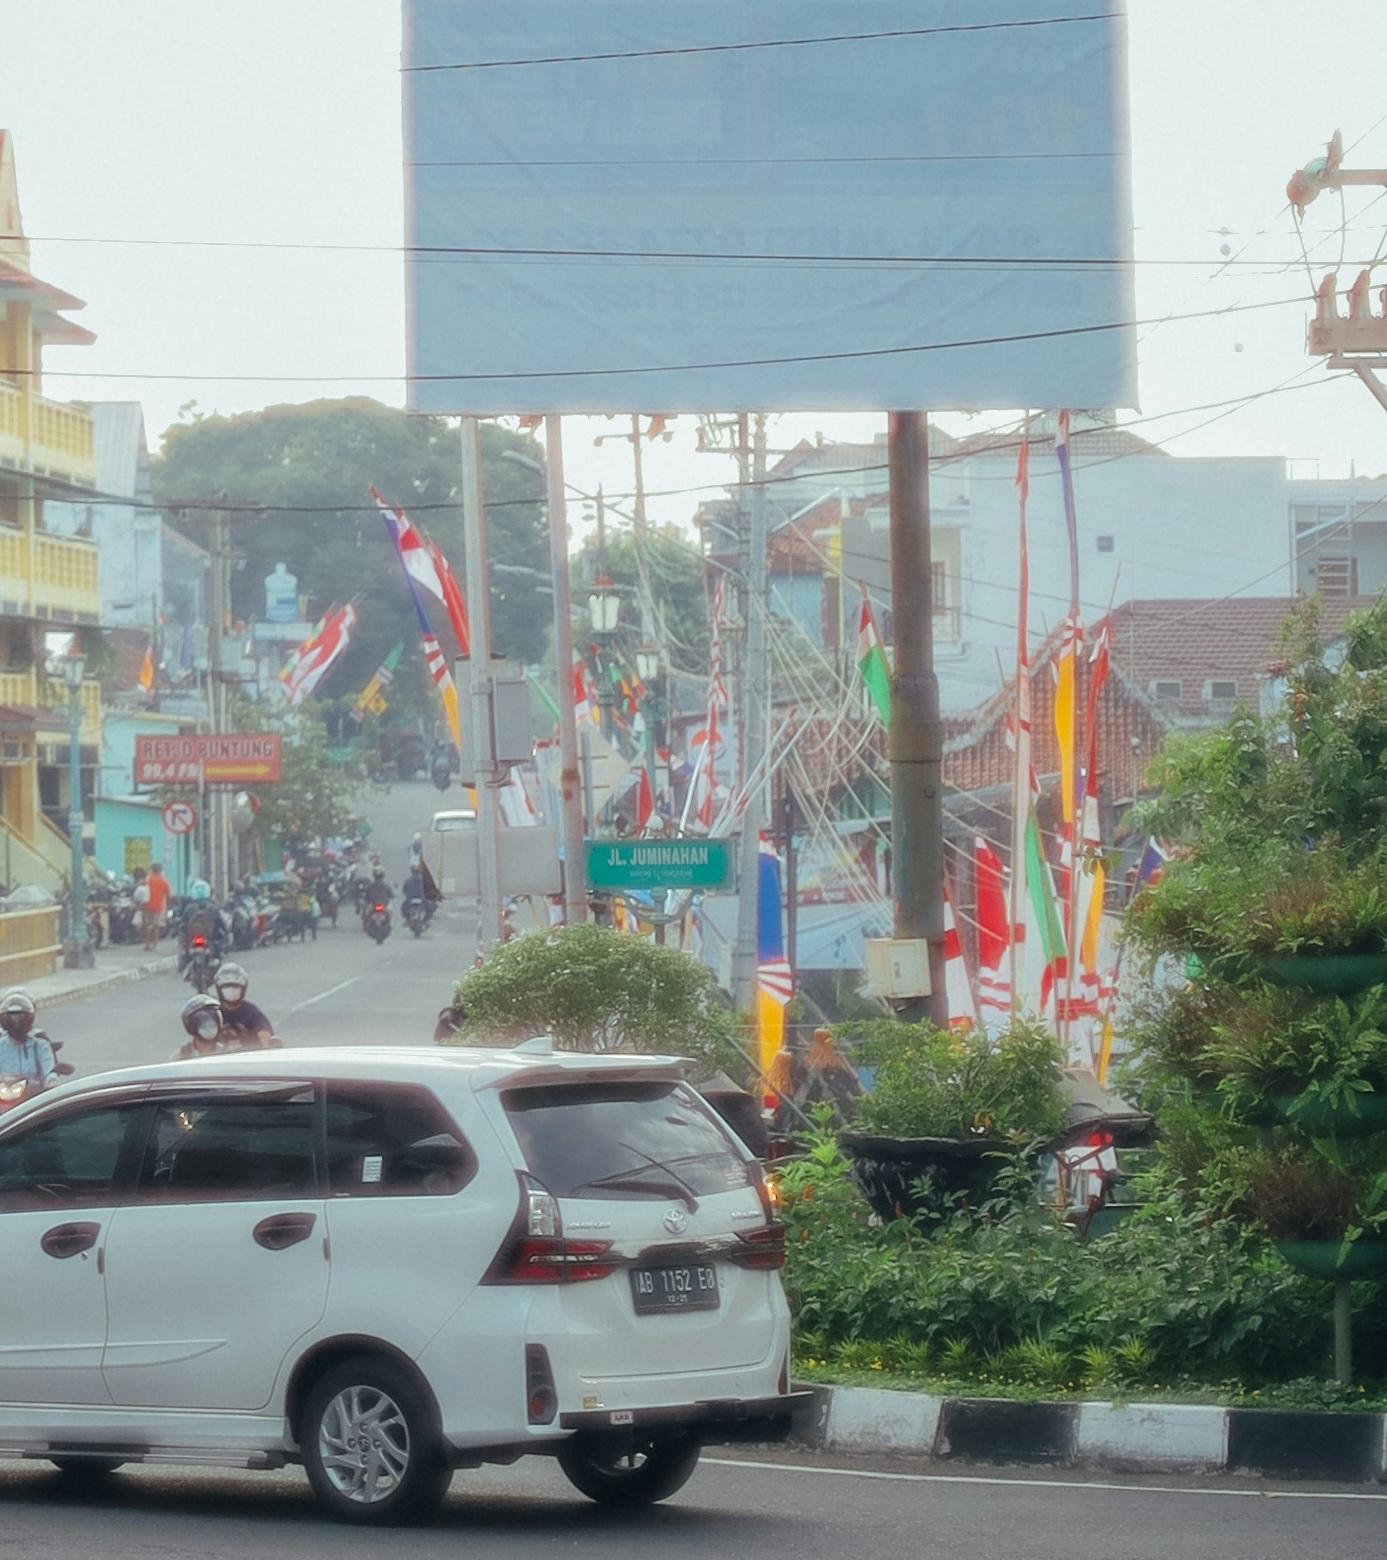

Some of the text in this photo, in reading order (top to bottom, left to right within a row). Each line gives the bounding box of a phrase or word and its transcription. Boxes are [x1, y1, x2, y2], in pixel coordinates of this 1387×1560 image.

[198, 740, 273, 758] BUNTUNG
[607, 847, 709, 866] JL. JUMINAHAN
[639, 1272, 654, 1294] AB
[661, 1269, 693, 1292] 1152
